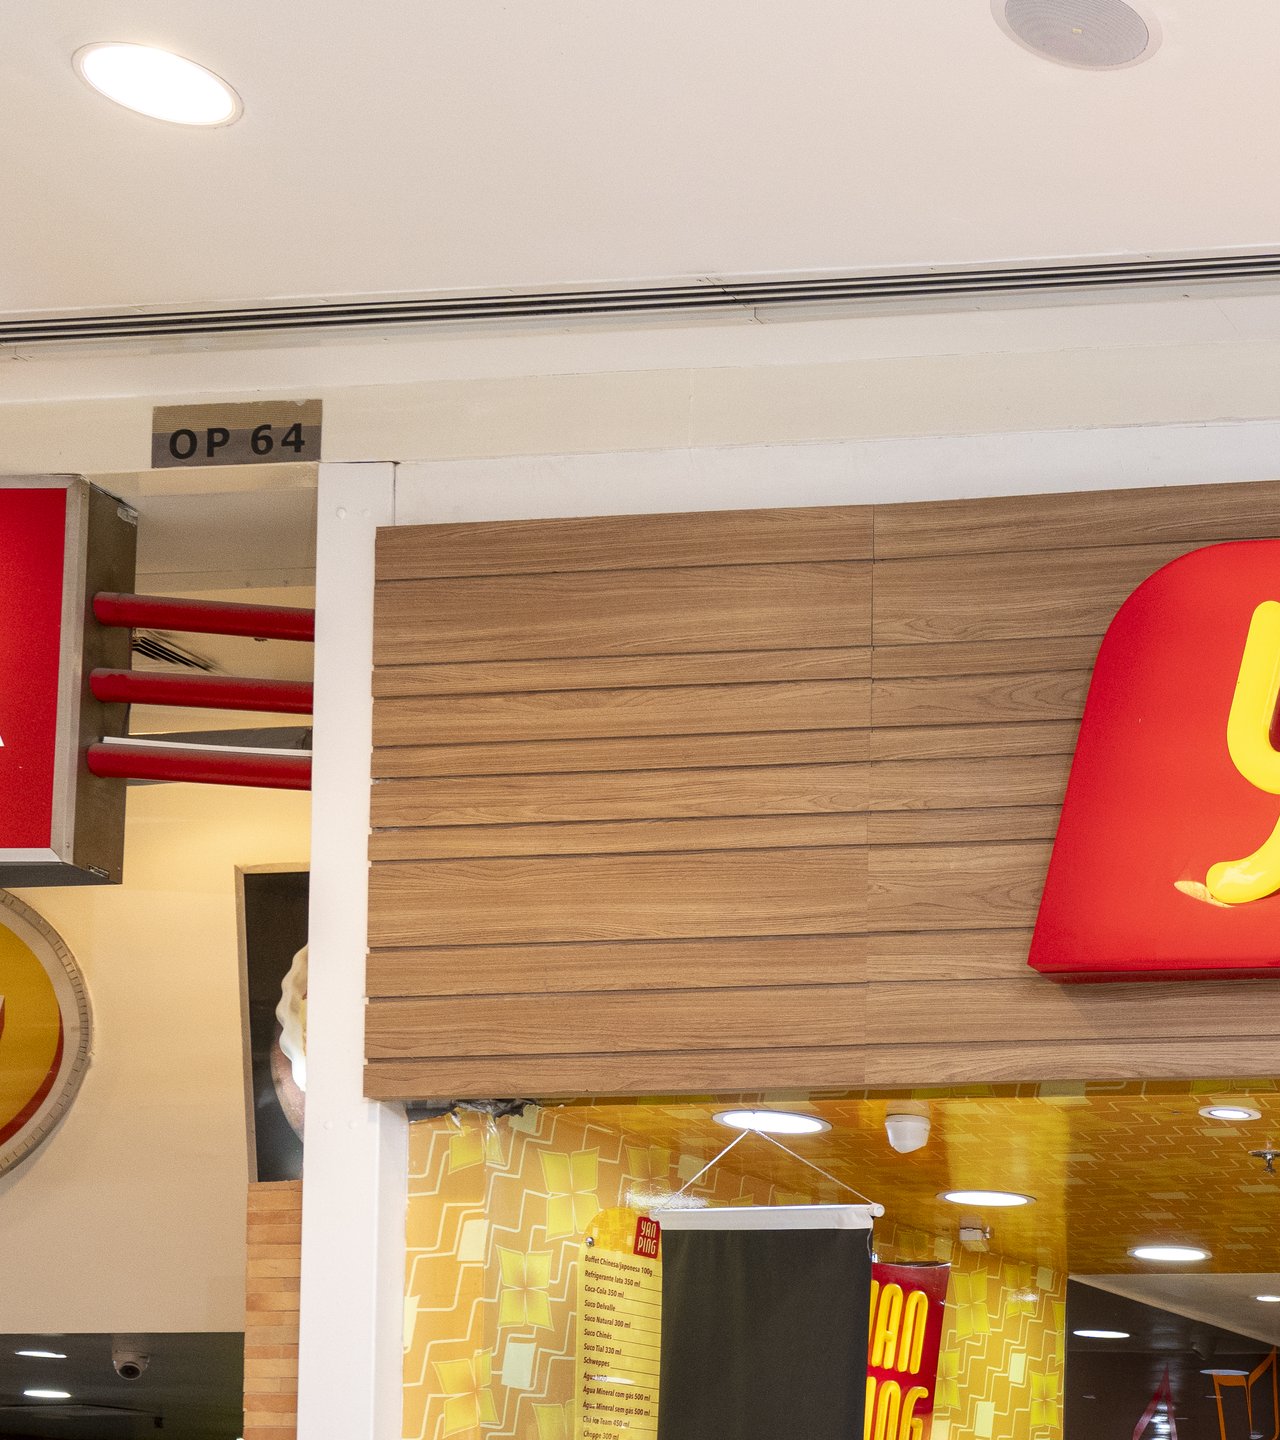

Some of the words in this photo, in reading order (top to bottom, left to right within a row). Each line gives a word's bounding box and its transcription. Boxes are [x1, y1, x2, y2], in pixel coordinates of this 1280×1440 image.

[168, 427, 231, 460] OP
[250, 423, 306, 456] 64
[637, 1236, 657, 1255] PING
[584, 1270, 614, 1283] Refrigerante
[615, 1275, 624, 1285] lata
[624, 1277, 634, 1286] 350
[634, 1280, 641, 1288] ml
[584, 1284, 607, 1295] Coca-Cola
[607, 1288, 618, 1297] 350
[584, 1300, 596, 1309] Suco
[584, 1314, 596, 1323] Suco
[596, 1316, 615, 1326] Natural
[615, 1319, 624, 1328] 300
[869, 1280, 929, 1375] AN
[584, 1328, 595, 1337] Suco
[583, 1343, 595, 1352] Suco
[615, 1348, 622, 1356] ml
[583, 1356, 610, 1369] Schweppes
[596, 1387, 615, 1397] Mineral
[615, 1391, 625, 1399] com
[634, 1393, 643, 1401] 500
[644, 1394, 651, 1402] ml
[596, 1403, 614, 1413] Mineral
[615, 1406, 625, 1414] sem
[634, 1408, 643, 1416] 500
[644, 1409, 651, 1417] ml
